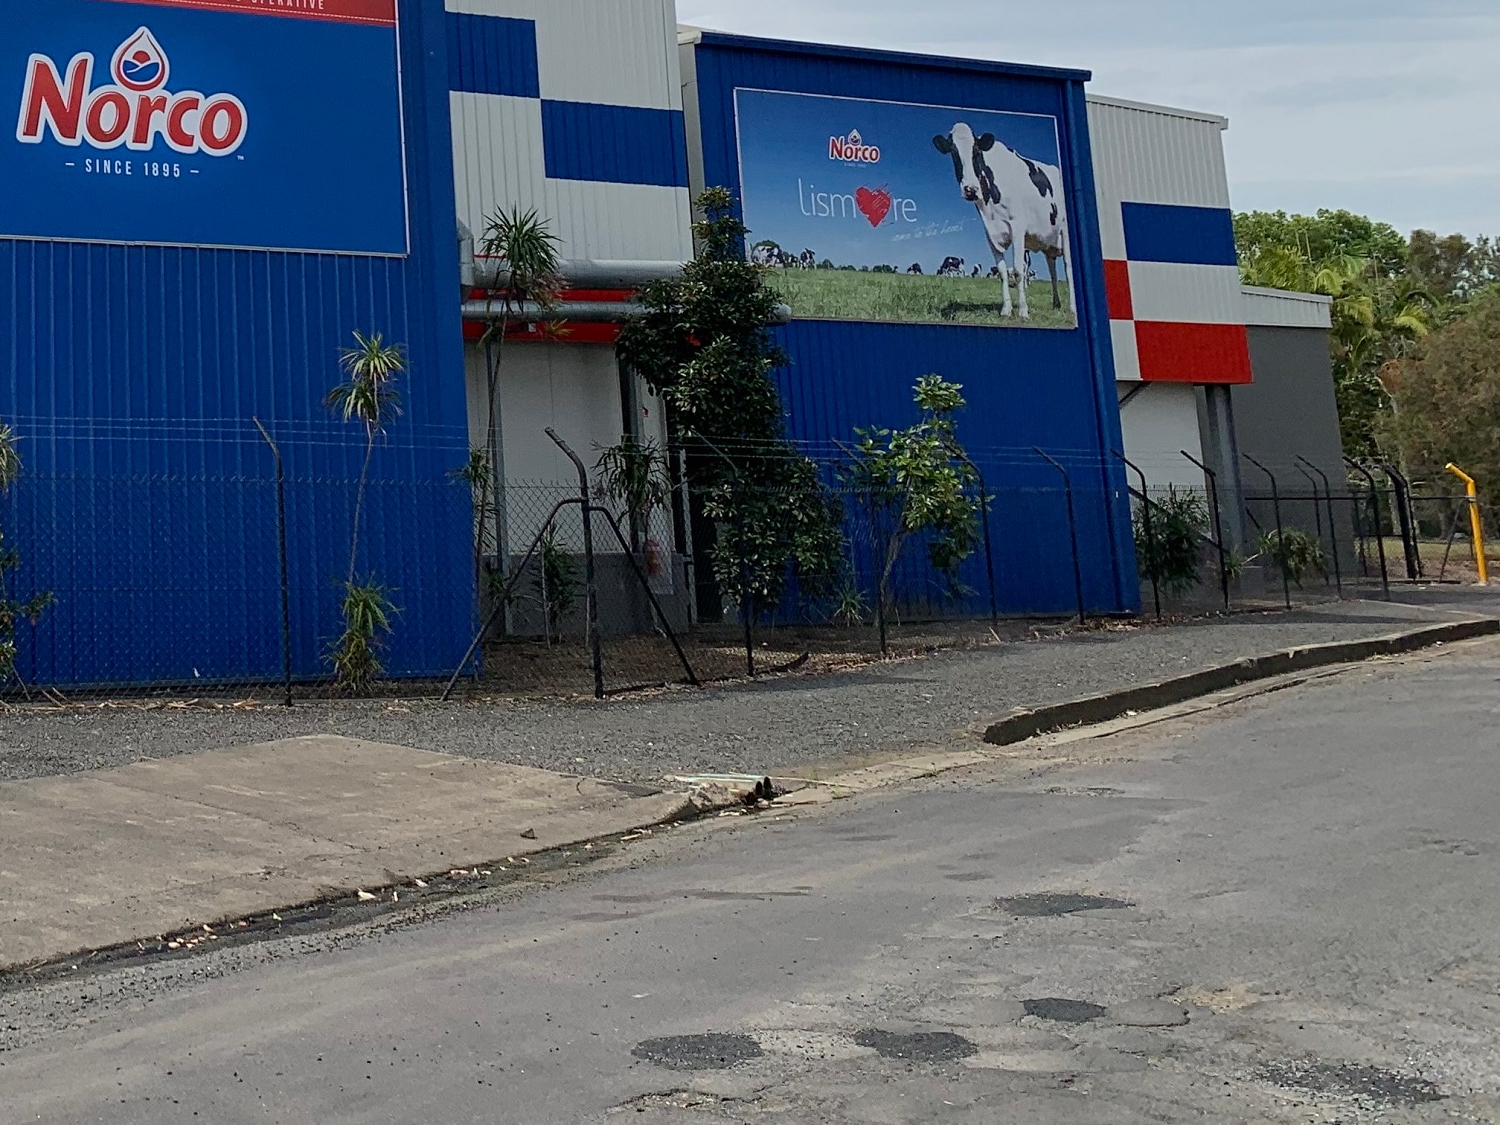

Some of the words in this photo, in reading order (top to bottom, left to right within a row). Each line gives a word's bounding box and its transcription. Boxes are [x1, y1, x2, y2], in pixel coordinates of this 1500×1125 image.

[17, 52, 247, 156] Norco
[829, 136, 880, 163] Norco
[85, 158, 132, 176] SINCE
[143, 161, 181, 178] 1895
